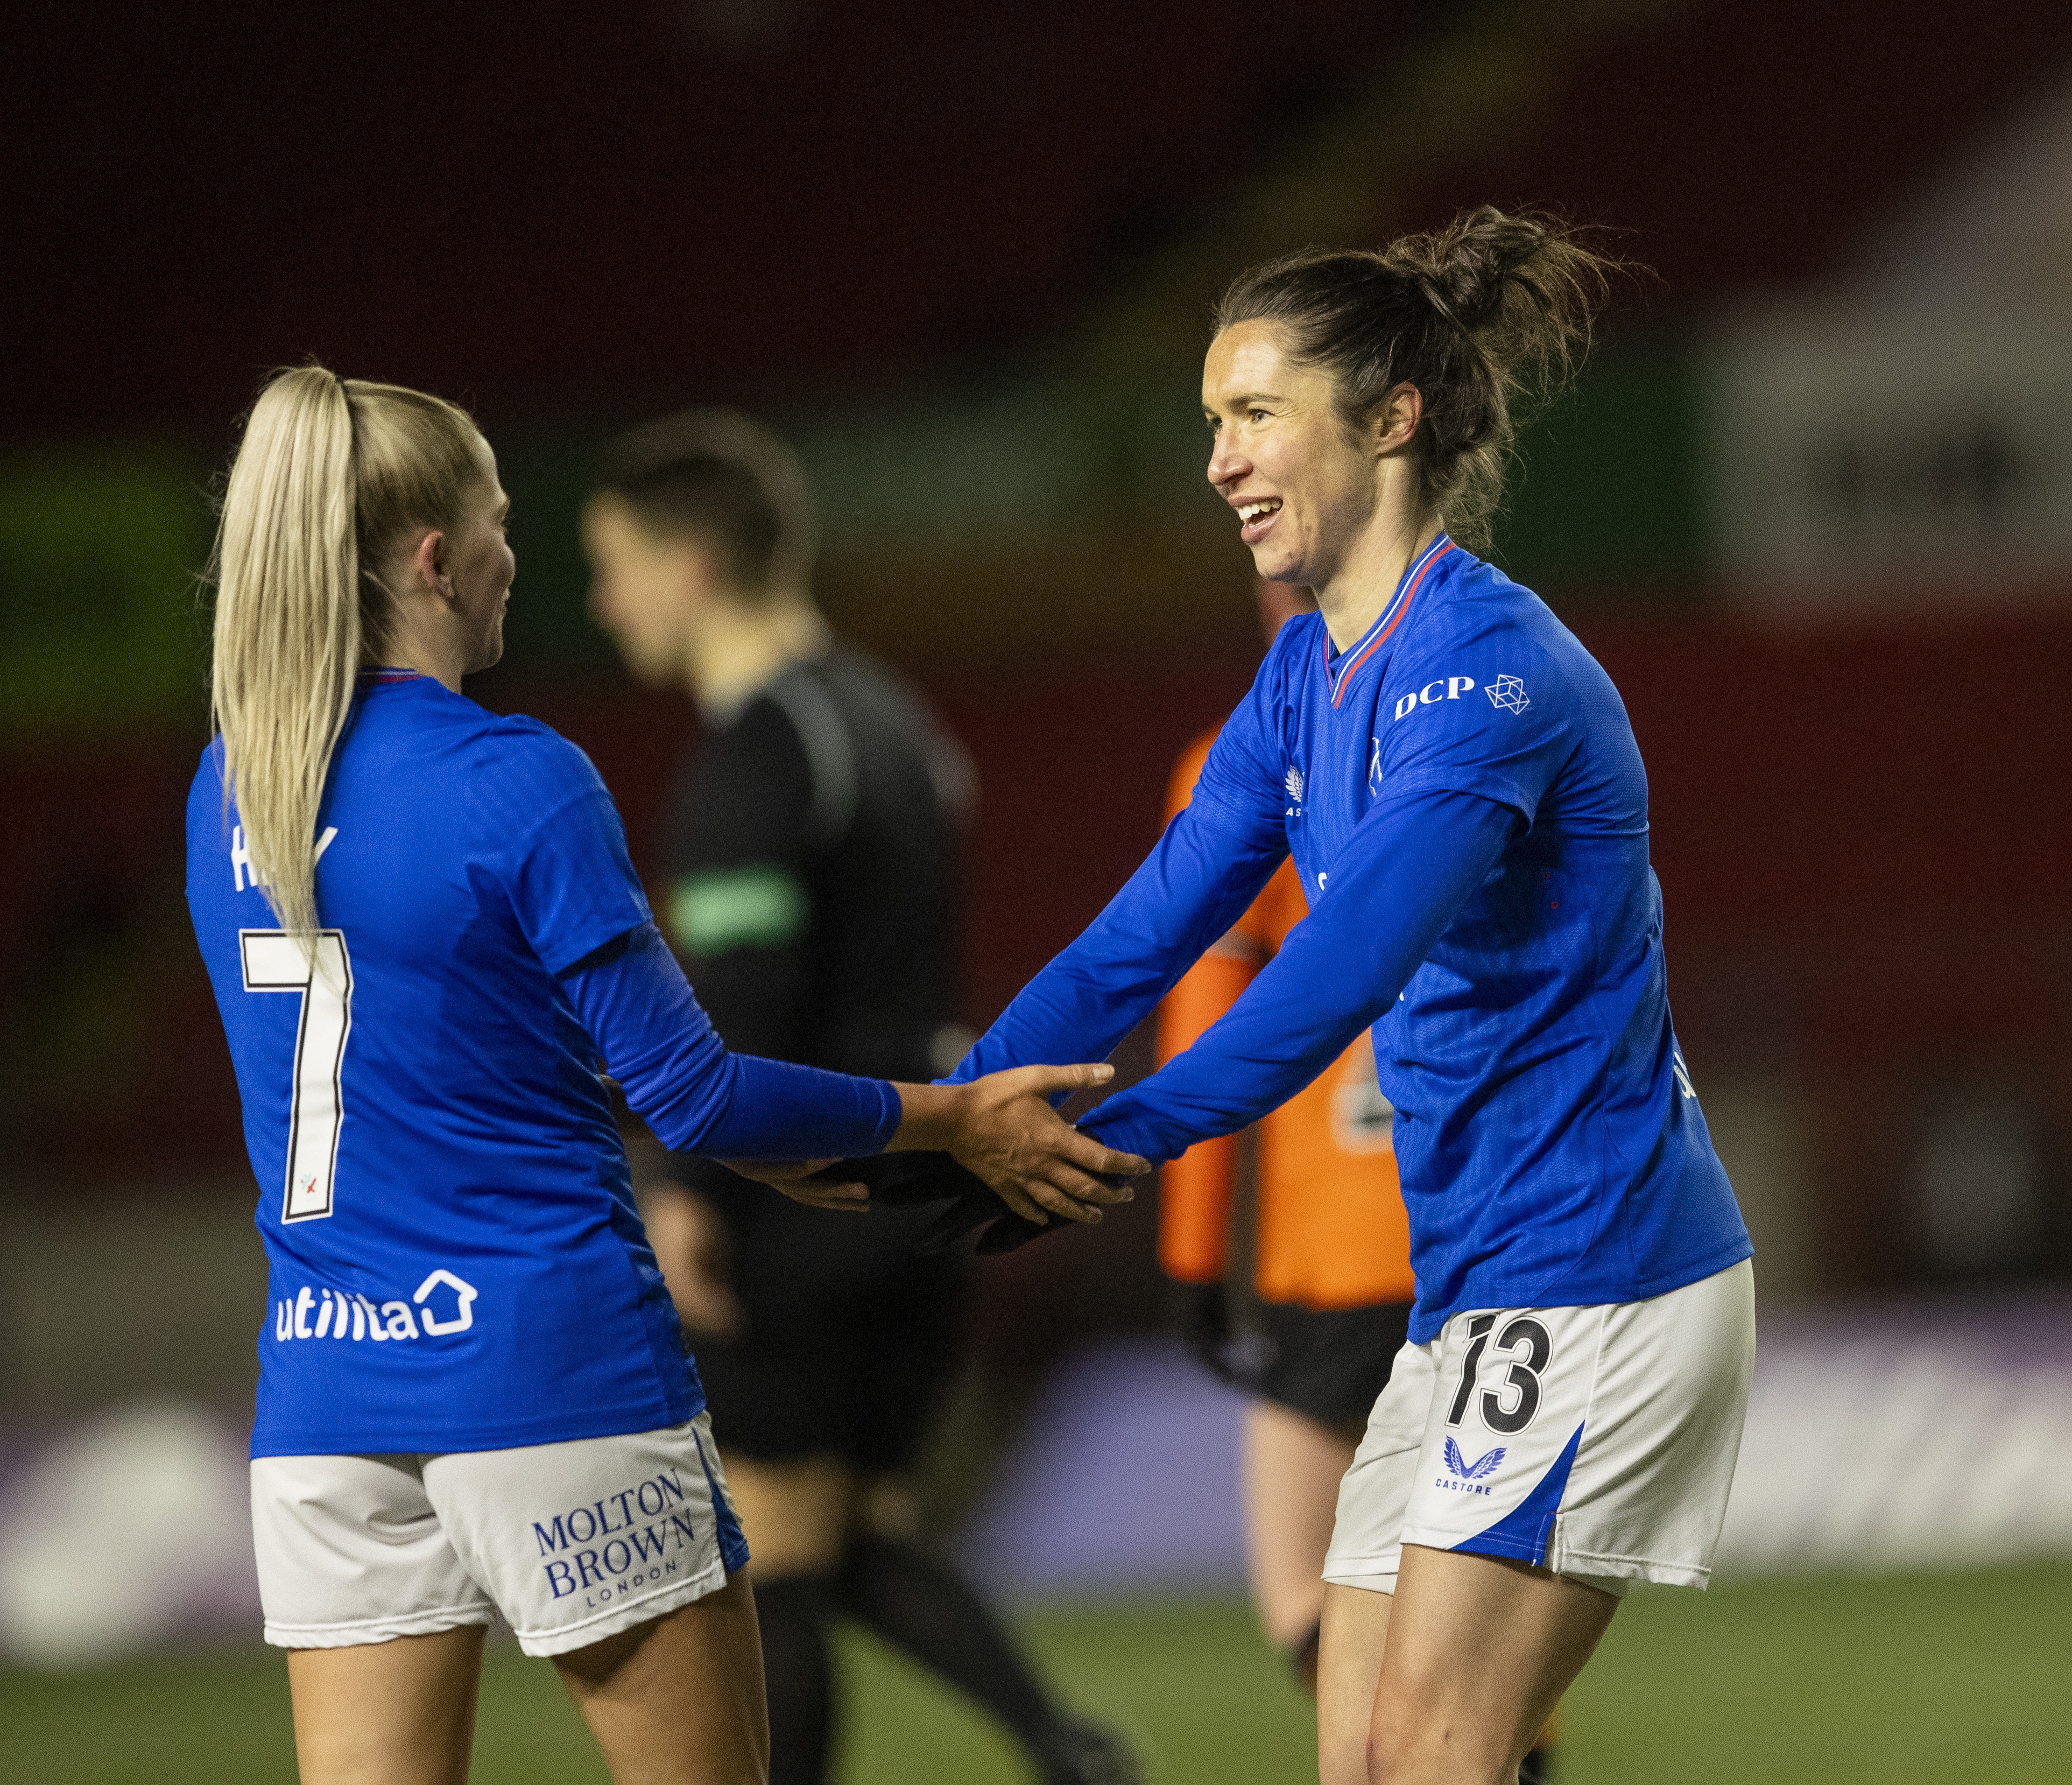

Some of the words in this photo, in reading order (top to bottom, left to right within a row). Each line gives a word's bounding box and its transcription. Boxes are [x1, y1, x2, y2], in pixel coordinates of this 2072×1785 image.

[1394, 676, 1475, 722] DCP
[238, 928, 354, 1225] 7
[276, 1286, 419, 1342] utilita
[1444, 1312, 1554, 1437] 13
[531, 1468, 685, 1557] MOLTON
[1435, 1478, 1491, 1496] CASTORE
[544, 1508, 695, 1599] BROWN
[586, 1561, 676, 1608] LONDON
